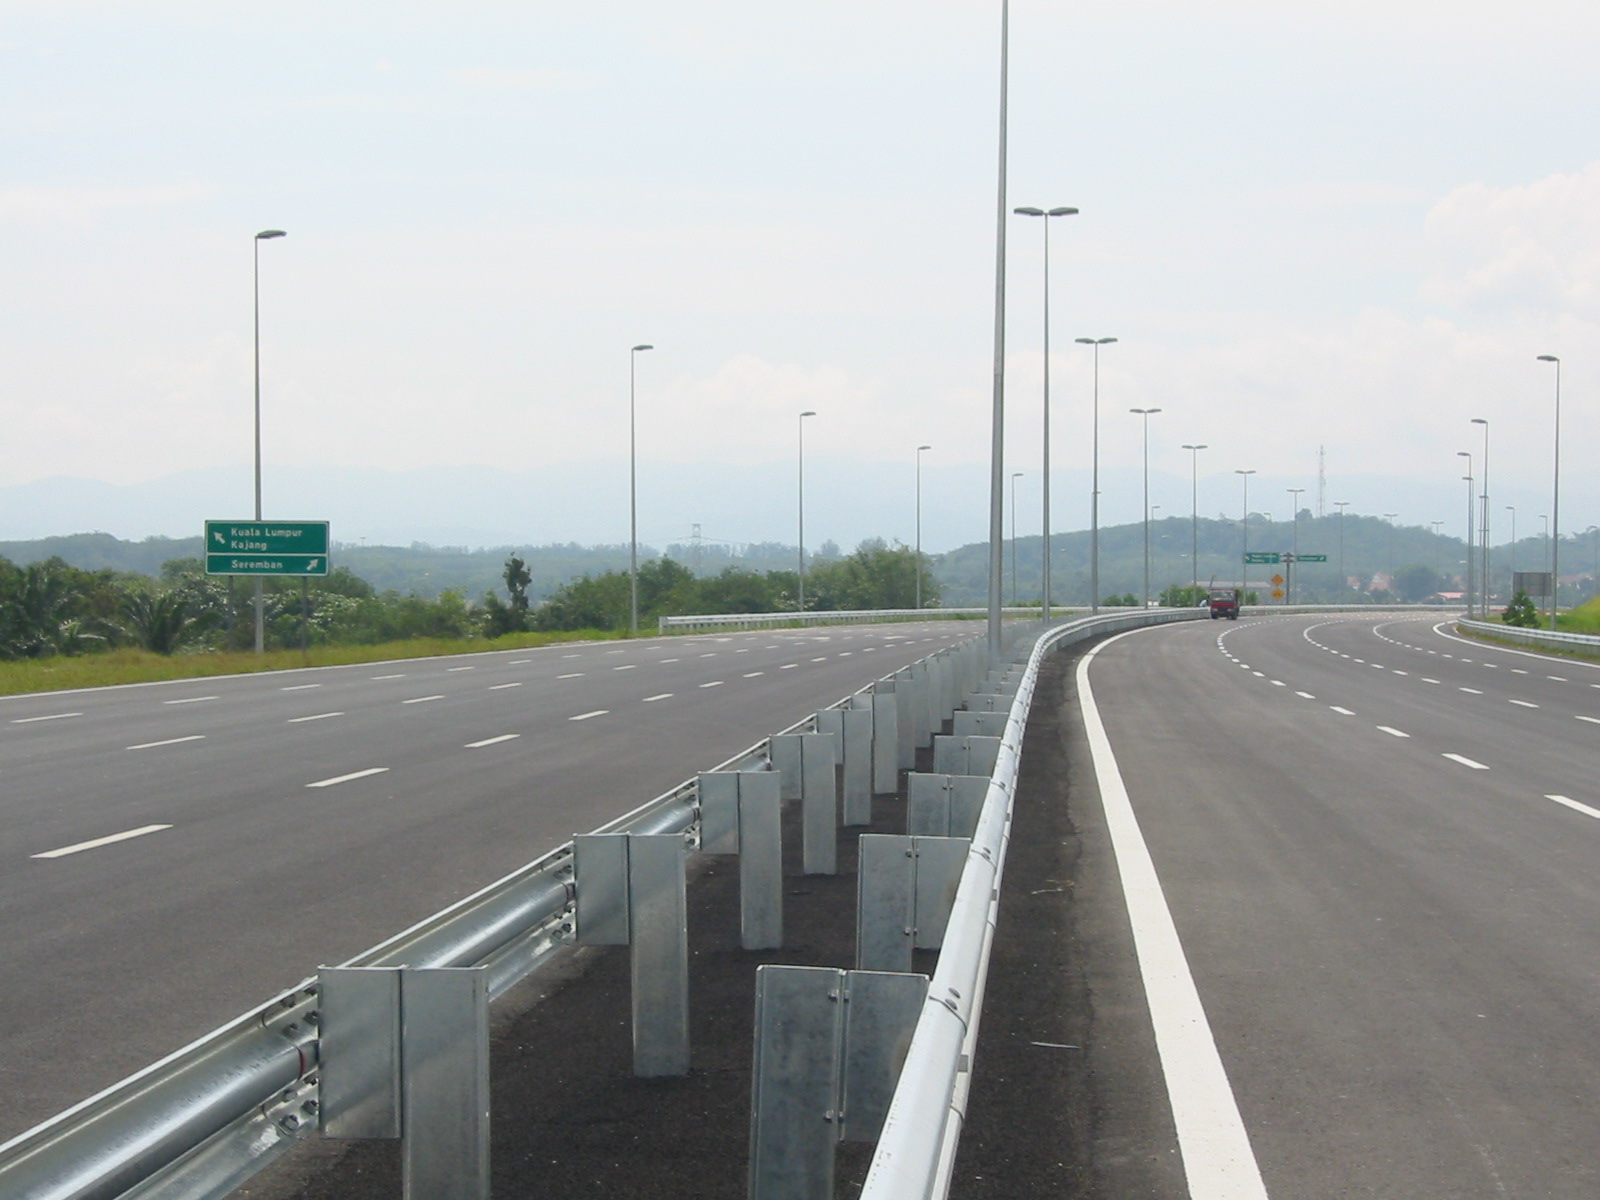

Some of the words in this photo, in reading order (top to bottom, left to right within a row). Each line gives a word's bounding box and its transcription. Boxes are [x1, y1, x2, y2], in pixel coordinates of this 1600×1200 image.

[231, 528, 260, 537] Kuala
[265, 528, 302, 538] Lumpur
[231, 540, 267, 551] Kajang
[231, 559, 283, 569] Seremban
